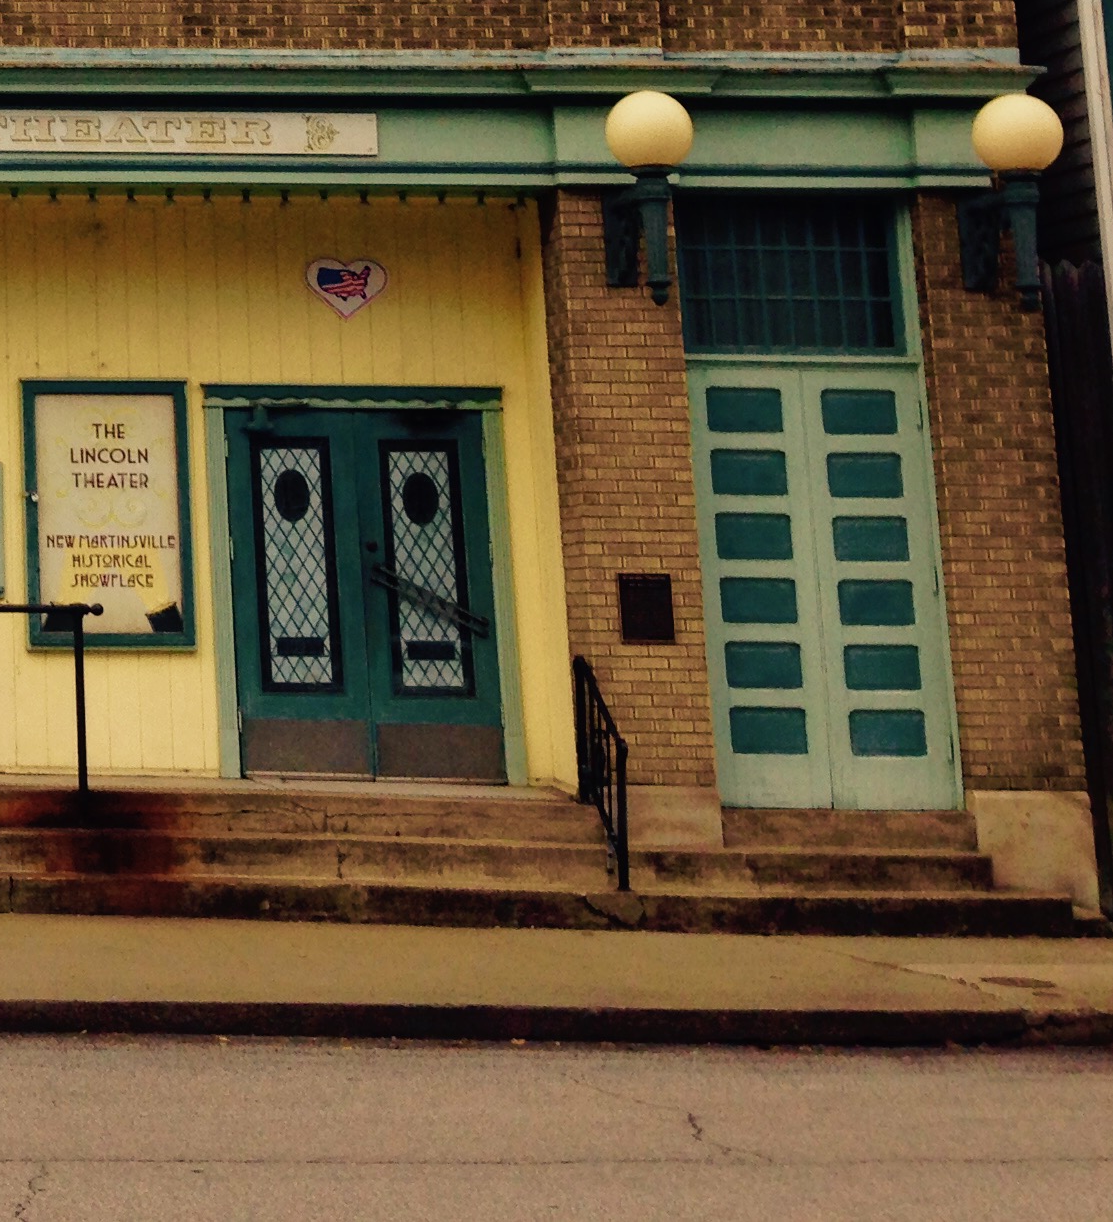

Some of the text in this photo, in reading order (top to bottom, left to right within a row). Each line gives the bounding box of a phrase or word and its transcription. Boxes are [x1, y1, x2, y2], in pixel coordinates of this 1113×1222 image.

[92, 423, 126, 440] THE
[70, 447, 149, 464] LINCOLN
[71, 472, 149, 489] THEATER
[46, 534, 176, 549] NEW MARTINSVILLE
[72, 554, 152, 569] HISTORICAL
[70, 573, 154, 588] SHOWPLACE
